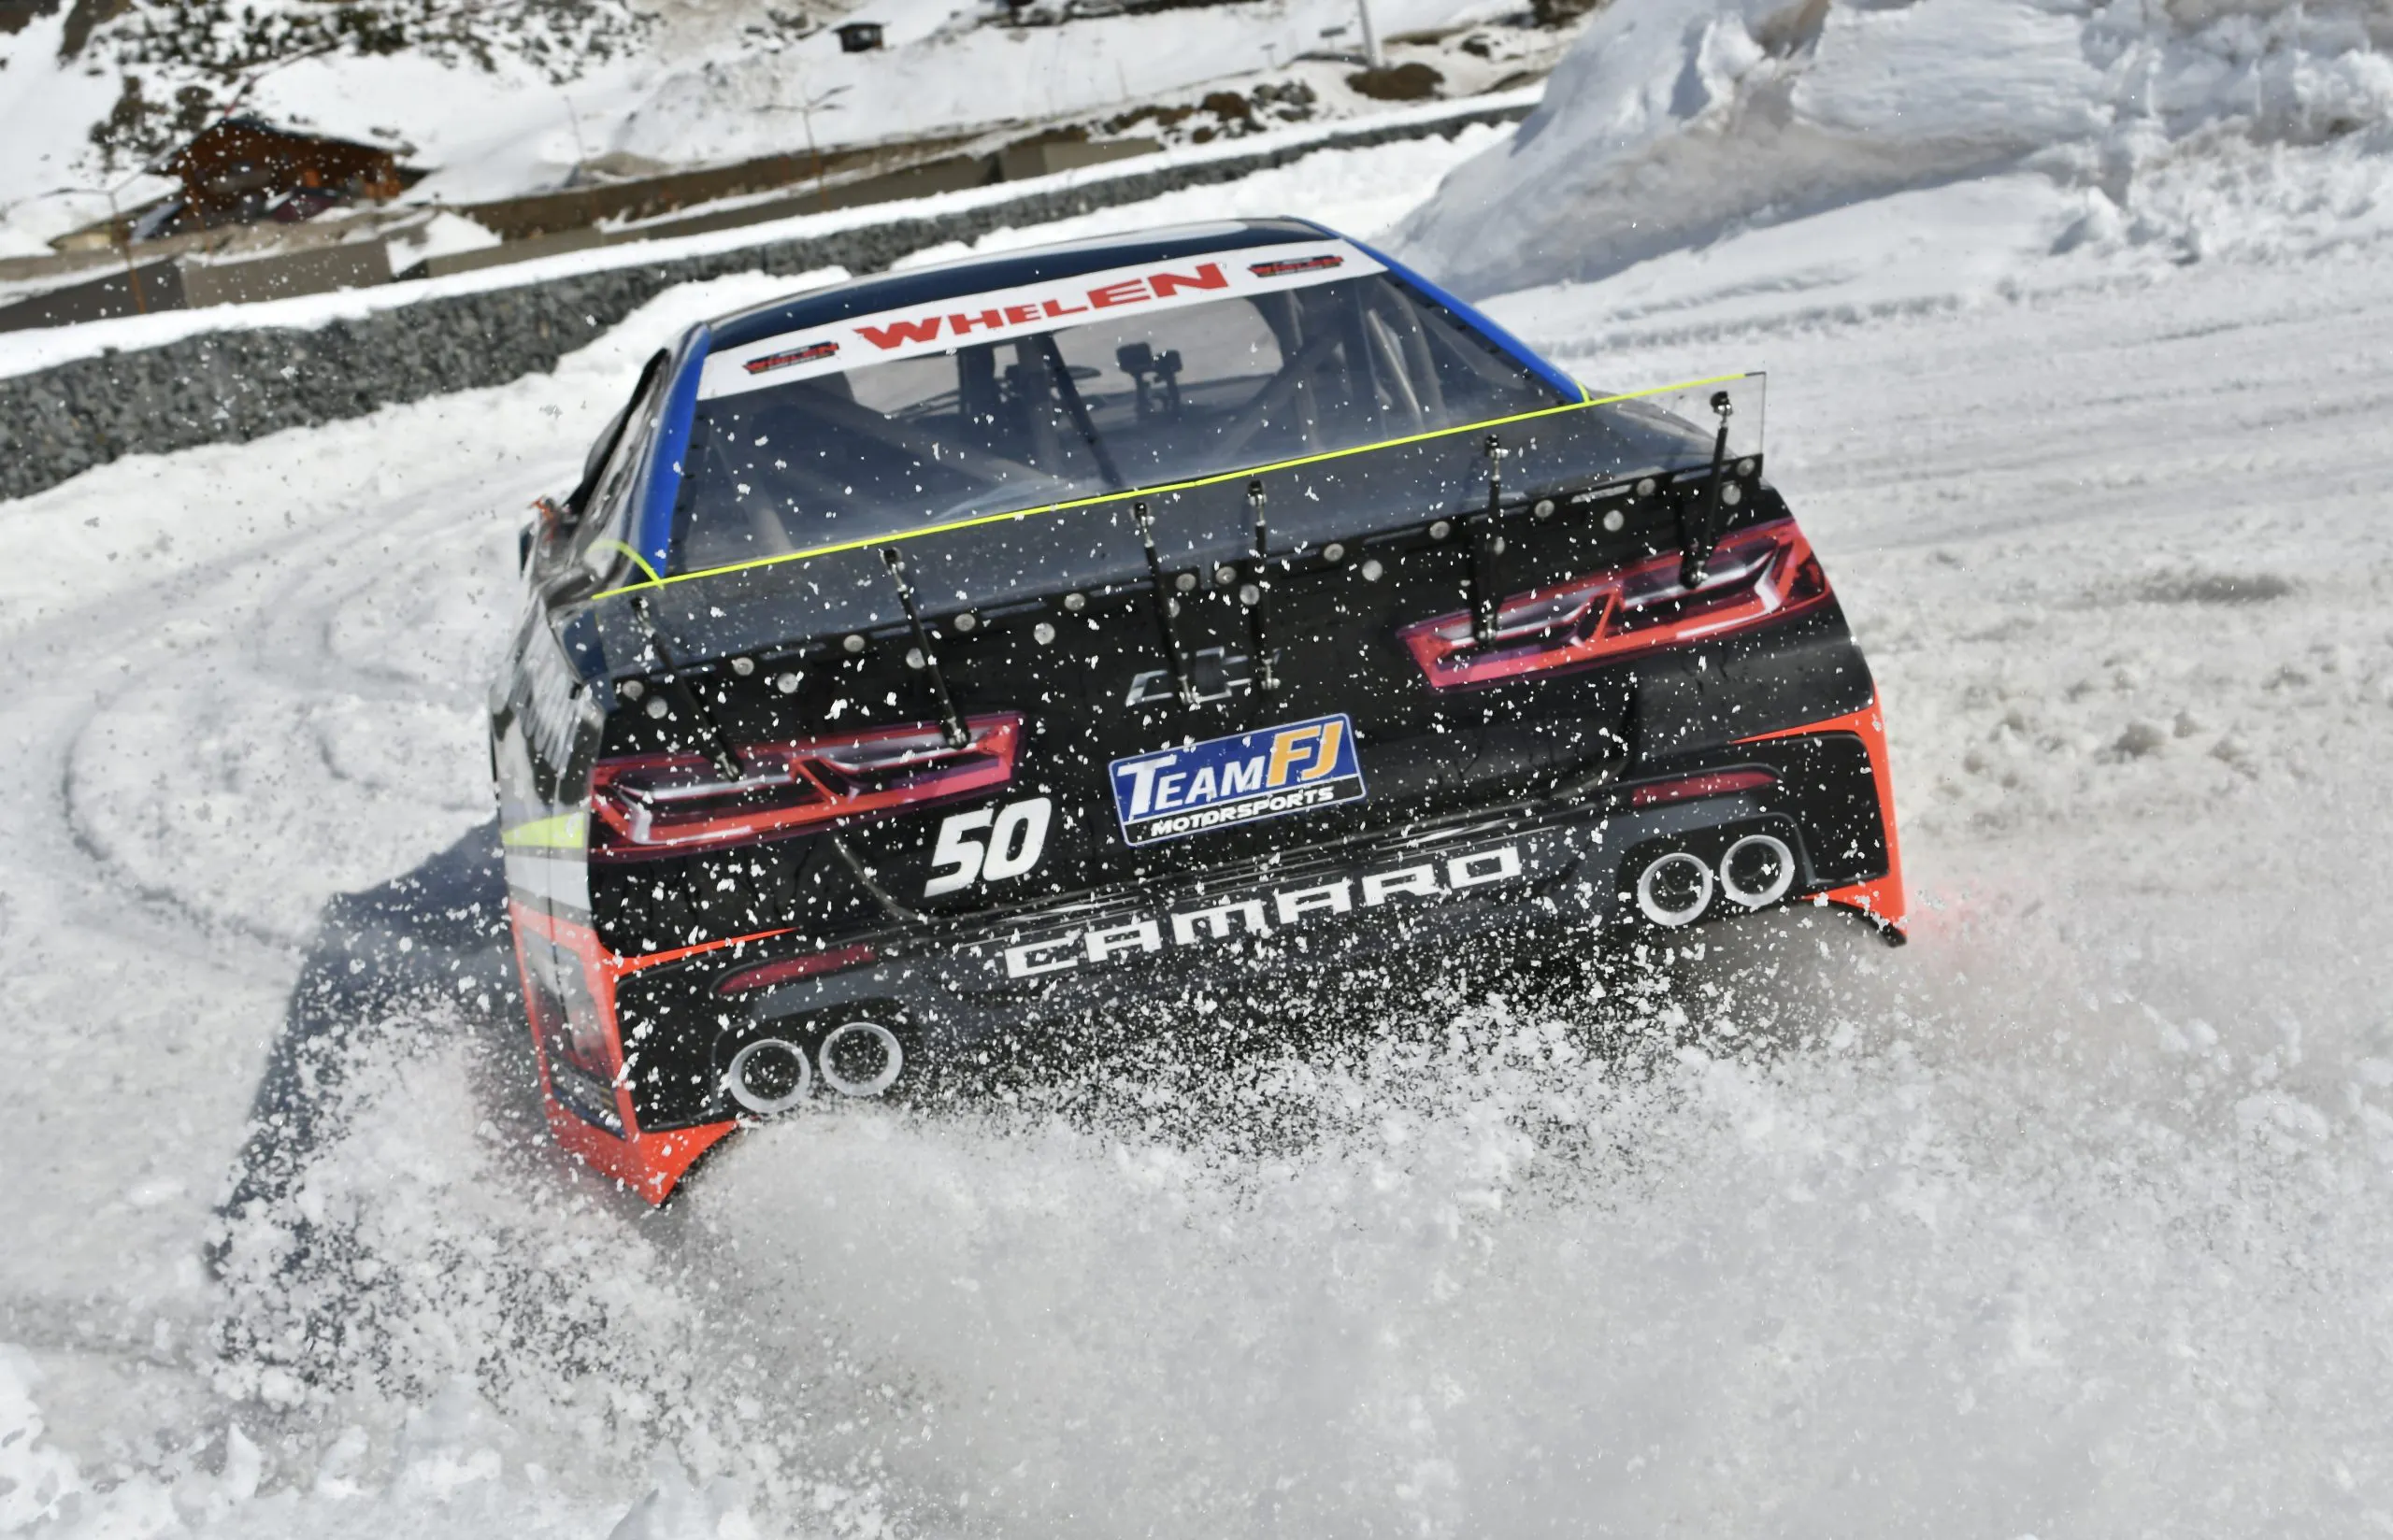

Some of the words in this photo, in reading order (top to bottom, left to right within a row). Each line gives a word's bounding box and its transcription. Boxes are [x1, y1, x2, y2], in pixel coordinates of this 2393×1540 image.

[853, 263, 1229, 349] WHELEN
[924, 797, 1053, 898] 50
[1150, 787, 1334, 837] MOTORSPORTS
[1004, 846, 1522, 978] CAMARO
